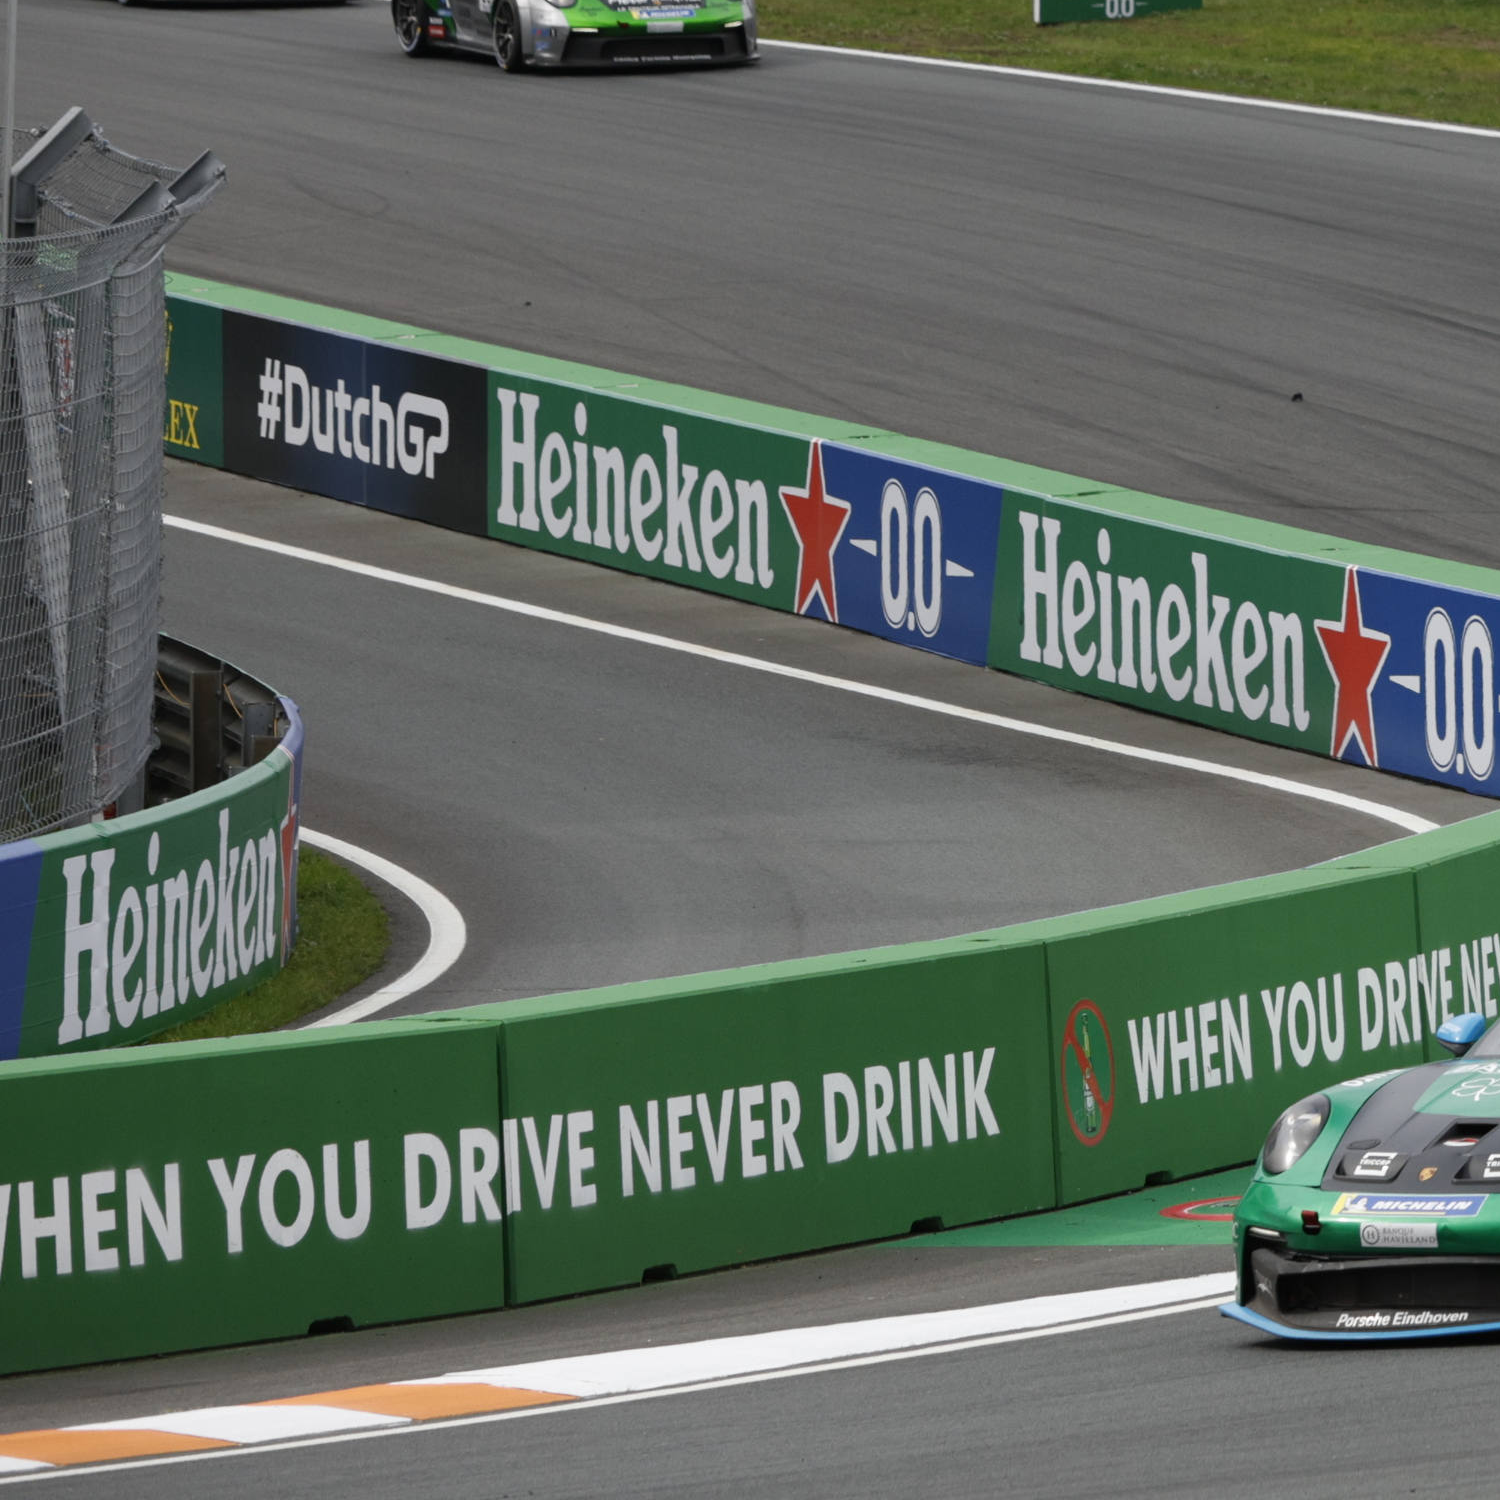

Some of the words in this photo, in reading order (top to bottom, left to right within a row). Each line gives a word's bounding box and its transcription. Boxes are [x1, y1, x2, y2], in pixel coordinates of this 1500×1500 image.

[256, 357, 449, 479] #DutchGP
[496, 387, 774, 589] Heineken
[1018, 510, 1310, 732] Heineken
[58, 807, 278, 1045] Heineken
[1128, 989, 1253, 1105] WHEN
[1260, 974, 1346, 1072] YOU
[1357, 947, 1455, 1052] DRIVE
[207, 1139, 372, 1255] YOU
[403, 1109, 598, 1230] DRIVE
[618, 1079, 803, 1198] NEVER
[822, 1045, 1001, 1165] DRINK
[1371, 1200, 1474, 1211] MICHELIN
[1335, 1313, 1391, 1329] Porsche
[1392, 1310, 1469, 1327] Eindhoven
